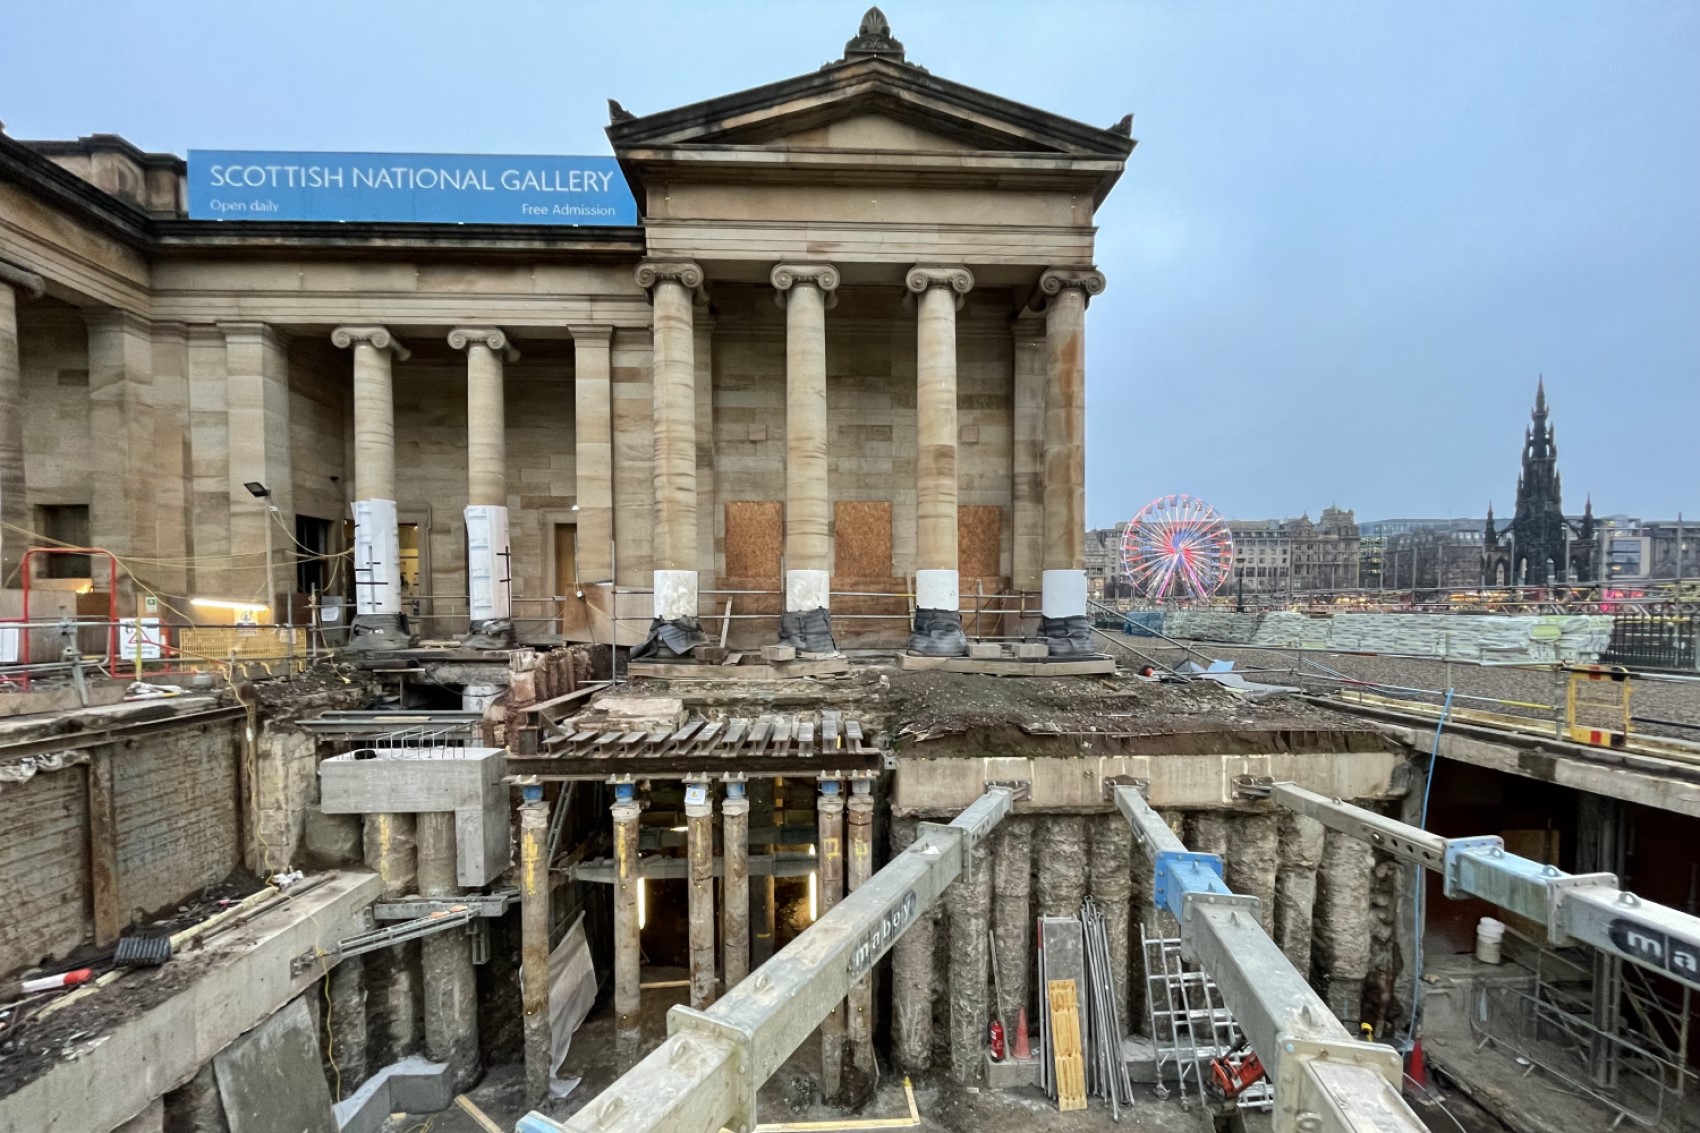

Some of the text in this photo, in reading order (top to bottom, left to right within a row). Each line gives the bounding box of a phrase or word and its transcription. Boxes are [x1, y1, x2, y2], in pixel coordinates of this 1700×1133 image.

[210, 165, 614, 192] SCOTTISH NATIONAL GALLERY
[210, 199, 280, 213] Open daily
[521, 203, 616, 216] Free Admission
[855, 892, 913, 967] mabey
